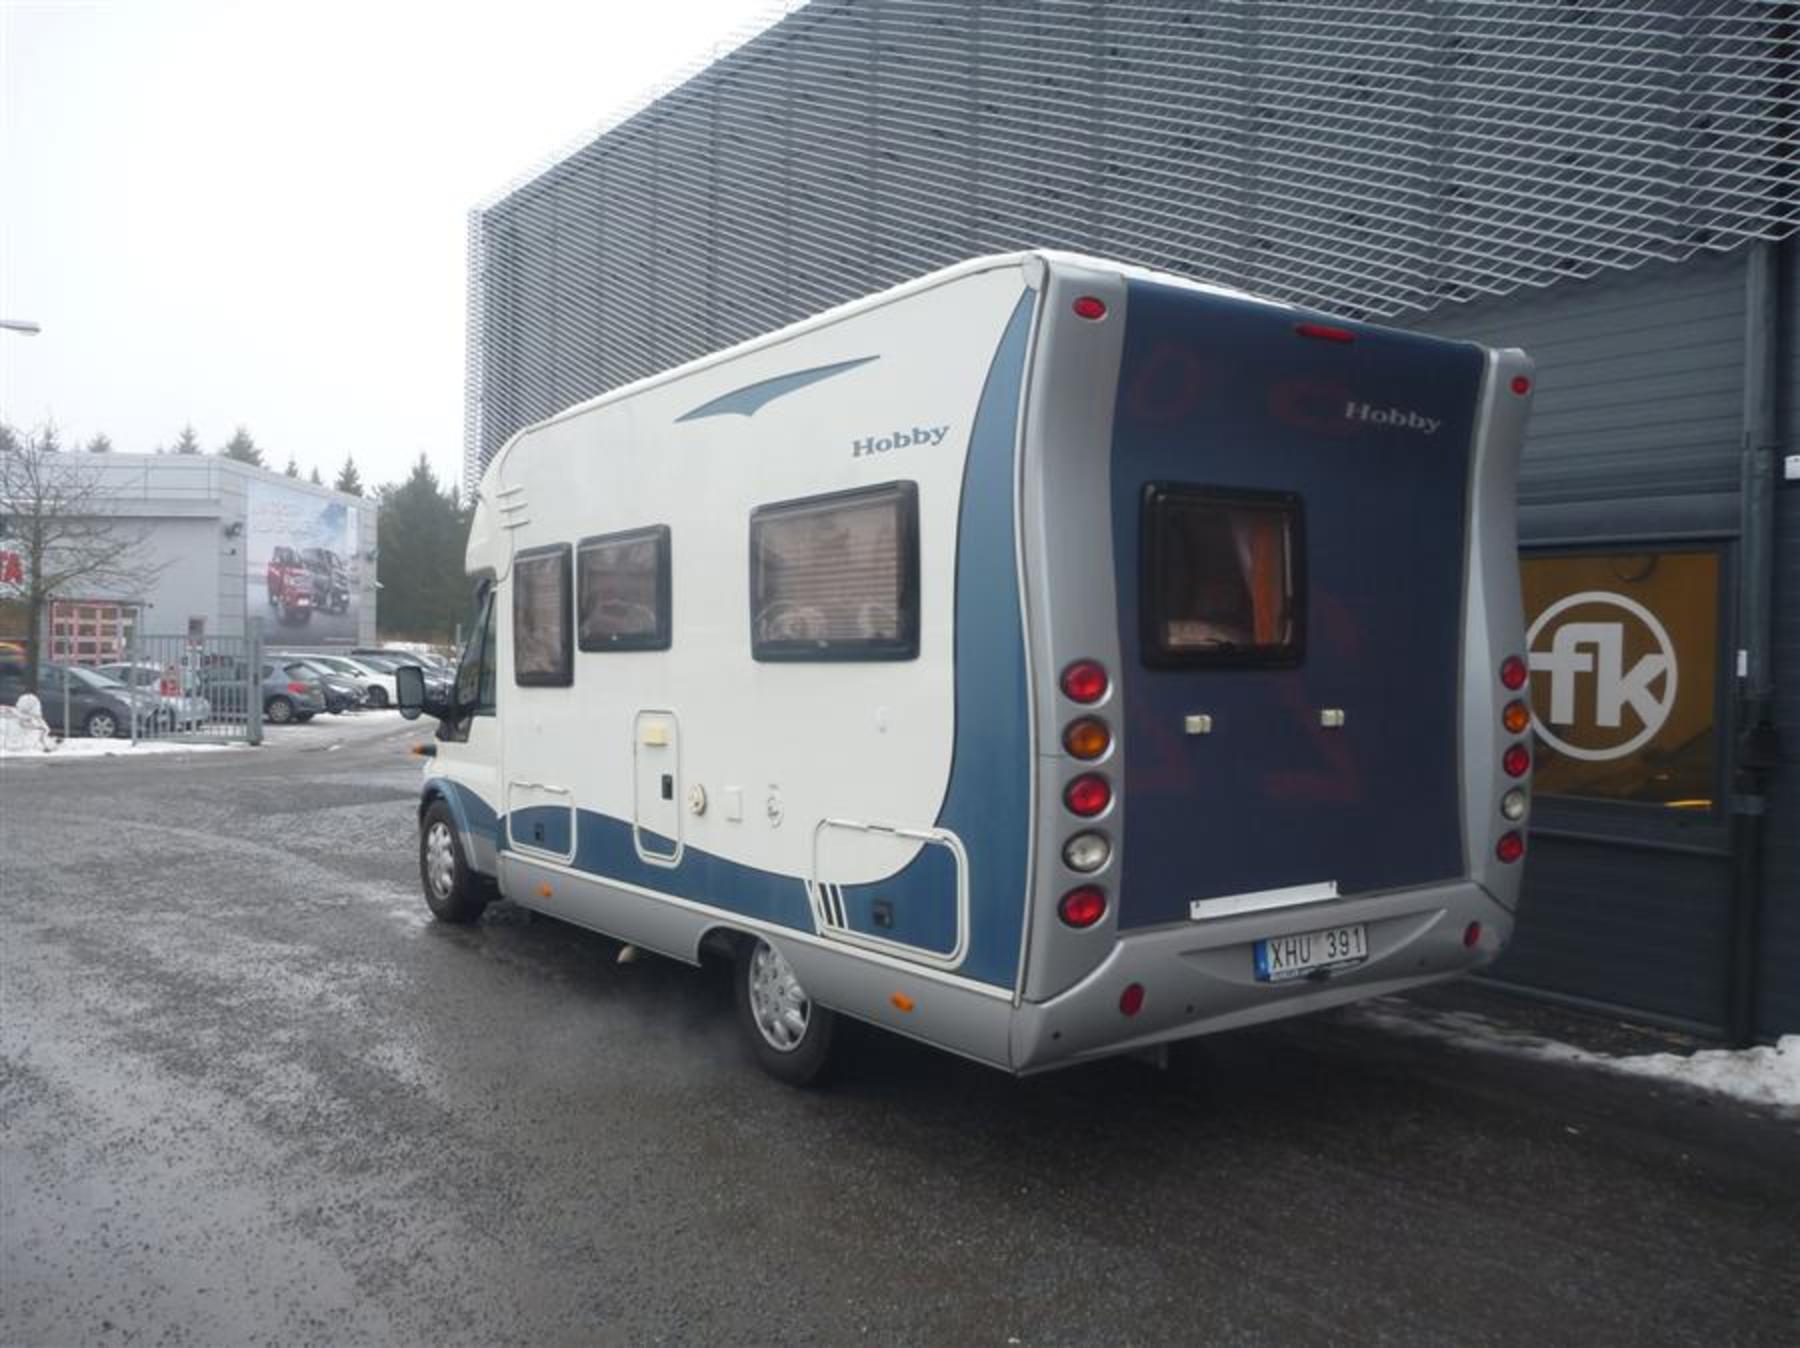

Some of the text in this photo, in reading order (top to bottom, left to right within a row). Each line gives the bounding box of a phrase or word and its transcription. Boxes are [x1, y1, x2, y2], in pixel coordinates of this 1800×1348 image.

[1345, 401, 1441, 434] Hobby
[852, 425, 950, 458] Hobby
[1271, 927, 1362, 969] XHU 391
